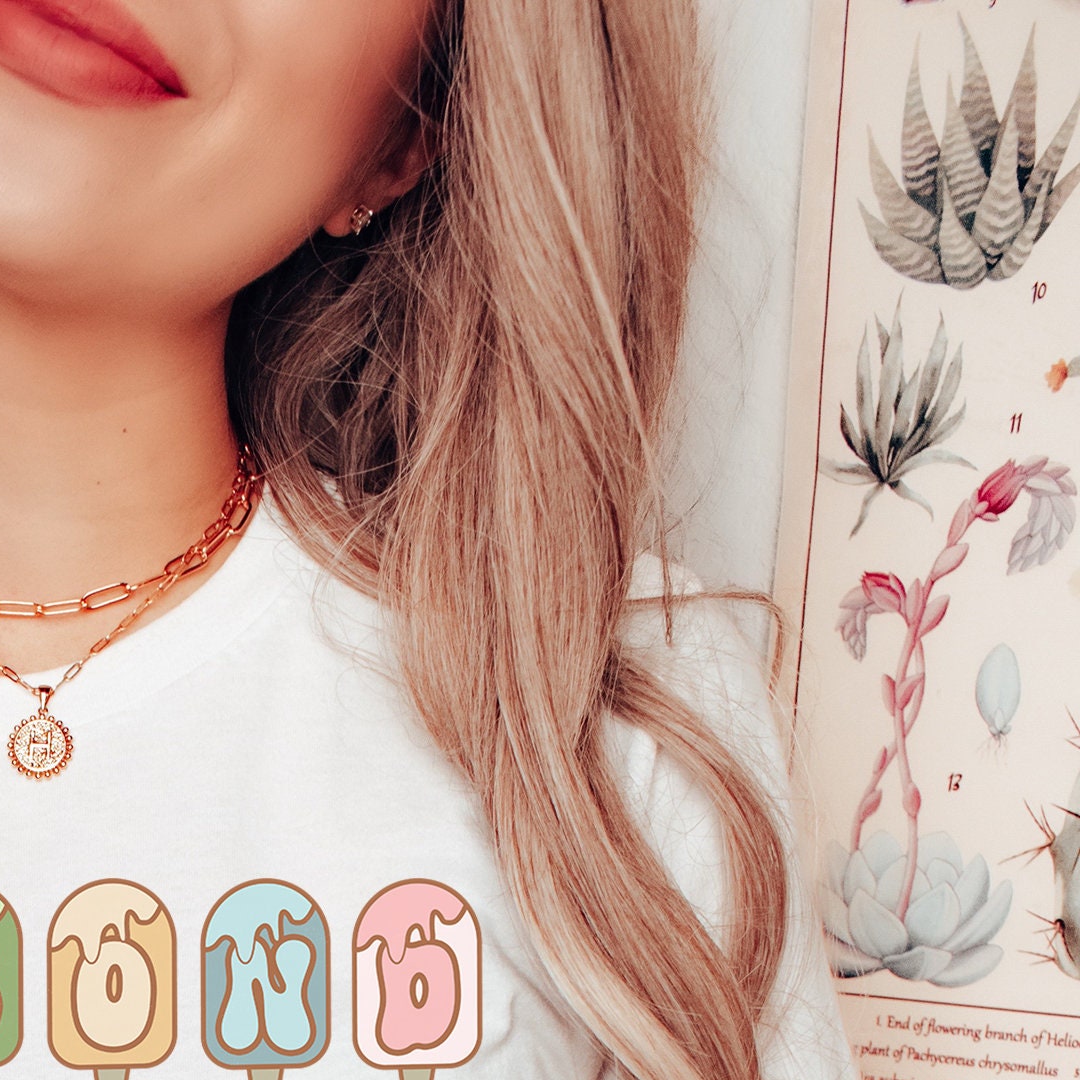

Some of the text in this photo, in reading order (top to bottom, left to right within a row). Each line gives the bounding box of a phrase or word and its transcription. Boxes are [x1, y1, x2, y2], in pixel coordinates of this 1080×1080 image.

[1031, 281, 1047, 304] 10
[1010, 413, 1023, 434] 11
[948, 773, 963, 792] 13
[887, 1014, 911, 1030] End
[913, 1017, 928, 1036] of
[923, 1018, 982, 1043] flowering
[985, 1024, 1027, 1043] branch
[1031, 1030, 1047, 1049] of
[860, 1040, 890, 1057] plant
[893, 1045, 908, 1063] of
[907, 1047, 975, 1067] Pachycereus
[978, 1054, 1058, 1077] chrysomallus
